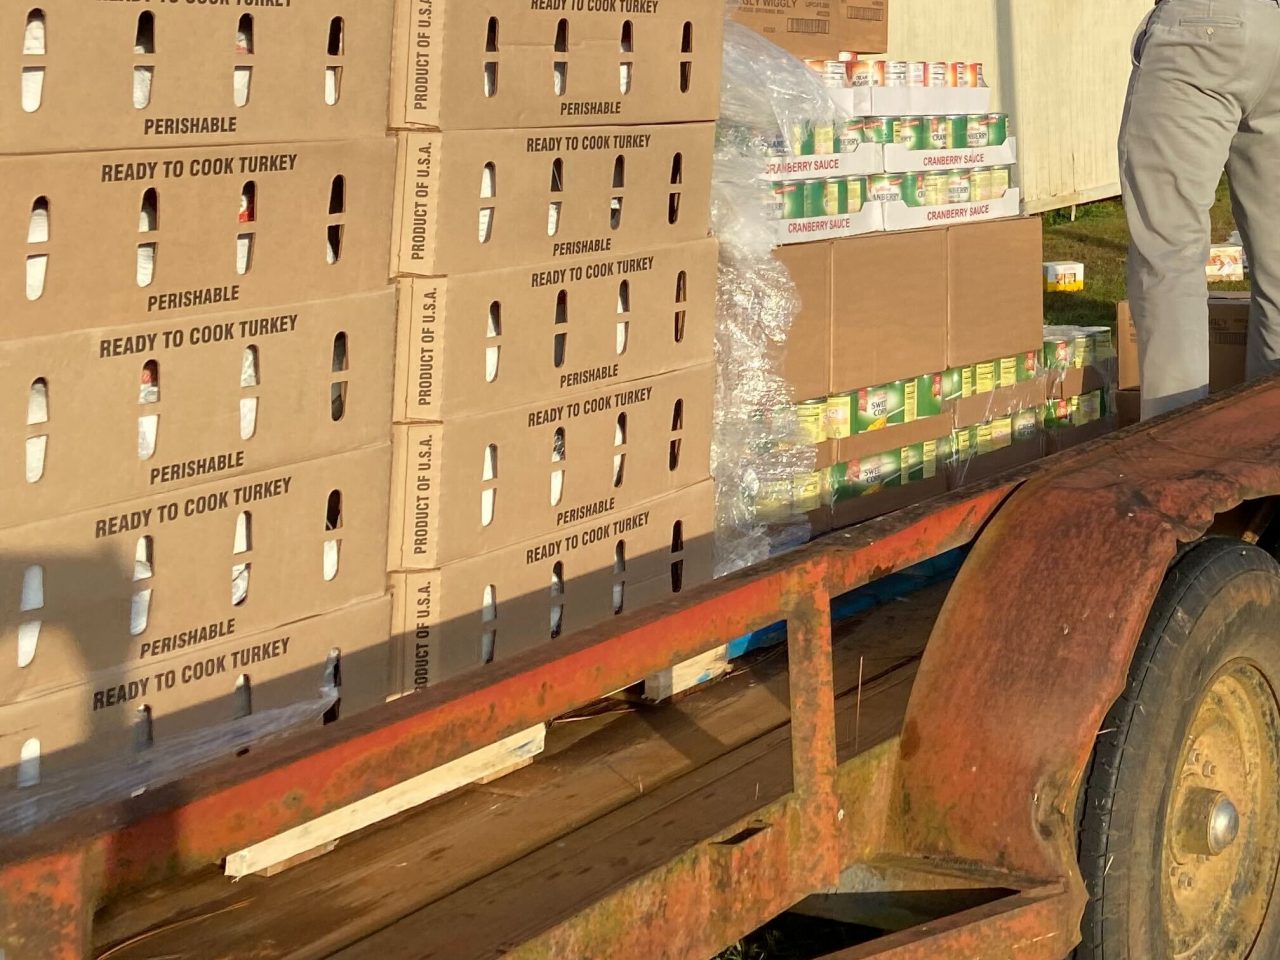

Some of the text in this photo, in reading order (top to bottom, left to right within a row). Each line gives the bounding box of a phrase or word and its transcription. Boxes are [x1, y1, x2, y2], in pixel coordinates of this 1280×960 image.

[587, 0, 617, 12] COOK
[619, 0, 659, 14] TURKEY
[417, 27, 431, 49] OF
[414, 49, 429, 111] PRODUCT
[560, 101, 621, 116] PERISHABLE
[144, 116, 237, 135] PERISHABLE
[527, 134, 651, 152] READY TO COOK TURKEY
[101, 154, 297, 182] READY TO COOK TURKEY
[814, 159, 839, 171] SAUCE
[923, 153, 985, 167] CRANBERRY SAUCE
[411, 141, 432, 261] PRODUCT OF U.S.A.
[927, 204, 990, 221] CRANBERRY SAUCE
[788, 218, 851, 234] CRANBERRY SAUCE
[552, 238, 611, 257] PERISHABLE
[531, 256, 654, 288] READY TO COOK TURKEY
[147, 285, 240, 312] PERISHABLE
[100, 314, 298, 358] READY TO COOK TURKEY
[418, 288, 437, 406] PRODUCT OF U.S.A.
[560, 364, 619, 388] PERISHABLE
[528, 386, 652, 428] READY TO COOK TURKEY
[151, 451, 244, 485] PERISHABLE
[95, 477, 292, 539] READY TO COOK TURKEY
[414, 434, 433, 555] PRODUCT OF U.S.A.
[557, 498, 615, 526] PERISHABLE
[526, 511, 650, 565] READY TO COOK TURKEY
[139, 618, 235, 659] PERISHABLE
[414, 581, 432, 691] ODUCT OF U.S.A.
[93, 637, 291, 711] READY TO COOK TURKEY
